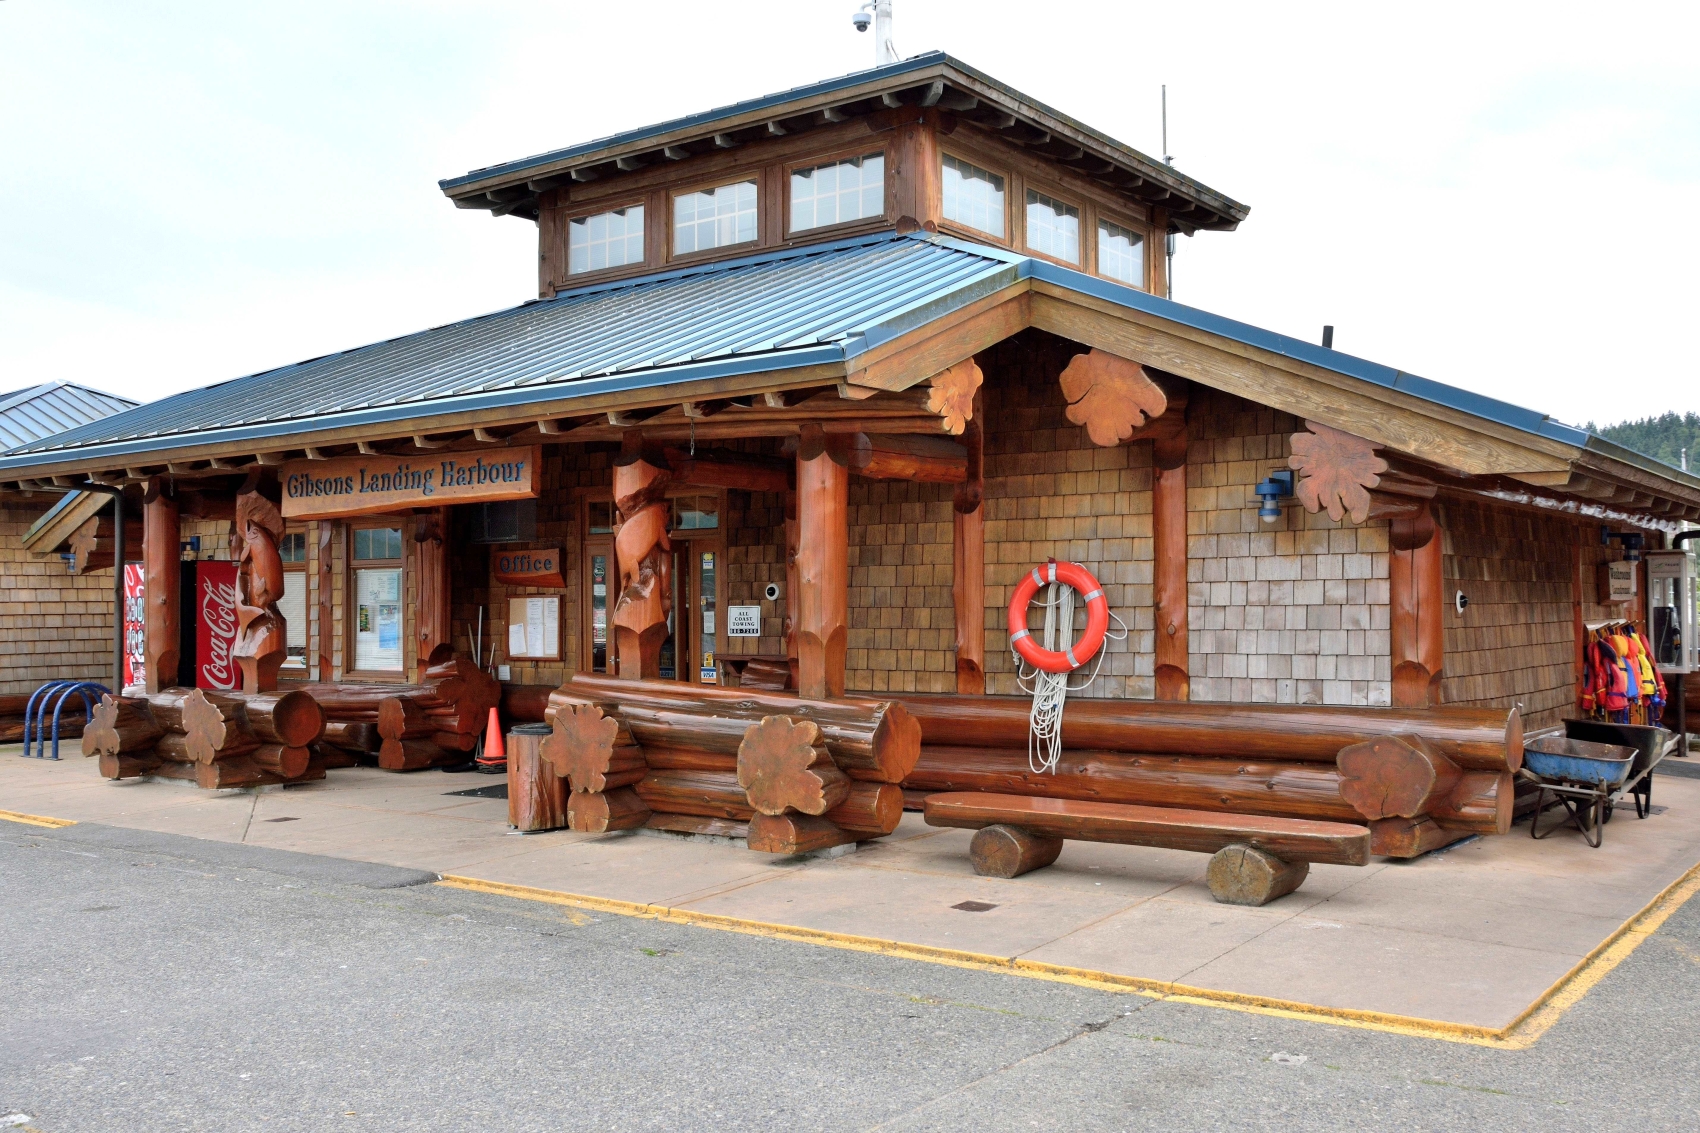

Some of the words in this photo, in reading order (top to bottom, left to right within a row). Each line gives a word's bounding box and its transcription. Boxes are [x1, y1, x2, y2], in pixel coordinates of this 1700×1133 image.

[287, 473, 354, 498] Gibsons
[359, 464, 434, 496] Landing
[440, 458, 525, 487] Harbour
[500, 554, 553, 573] Office
[203, 575, 236, 690] Coca-Cola
